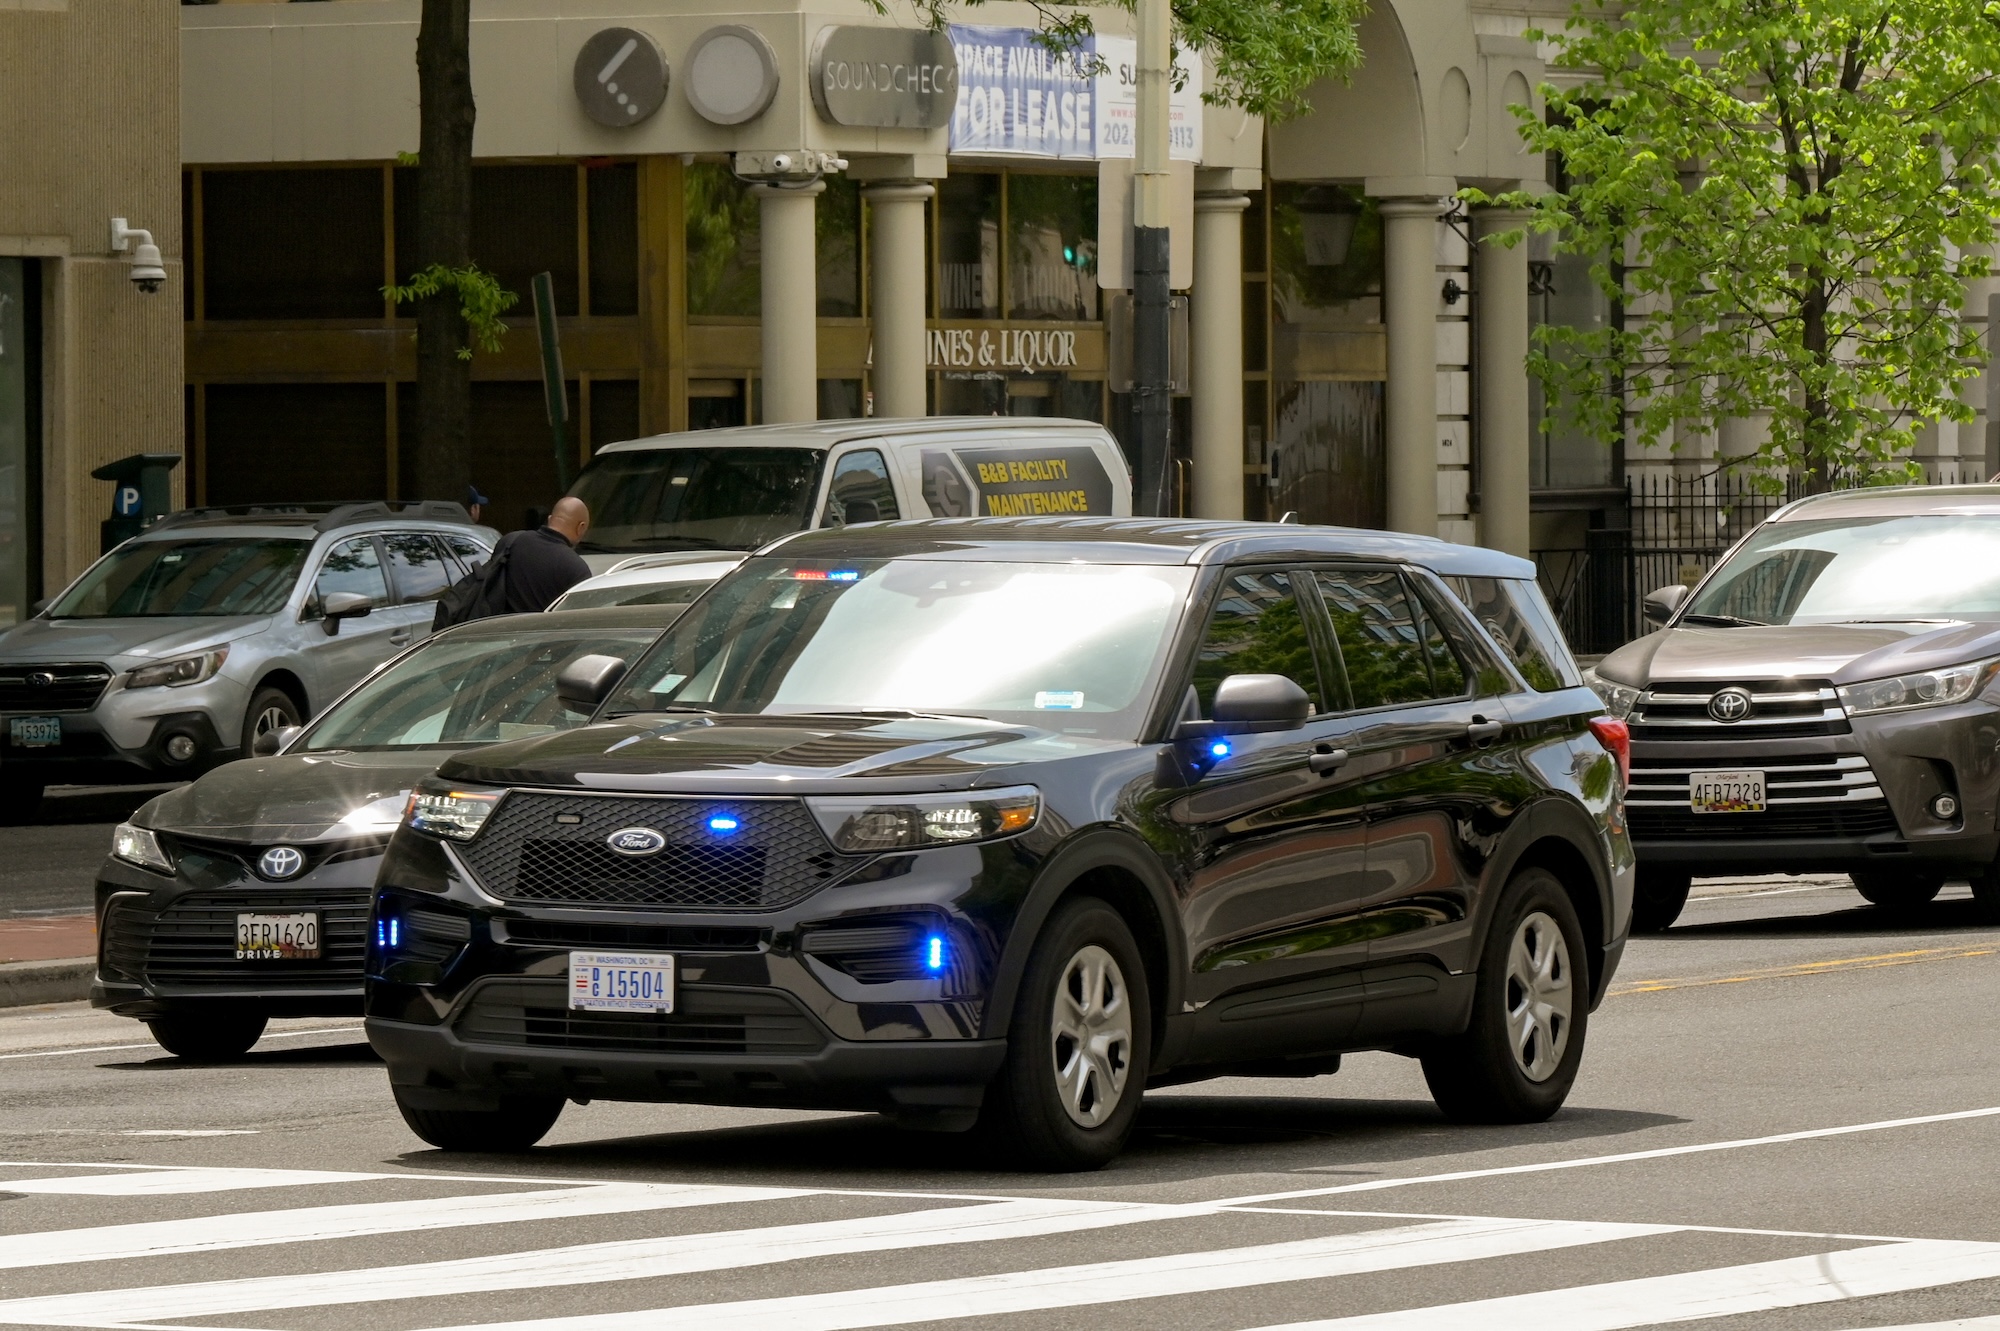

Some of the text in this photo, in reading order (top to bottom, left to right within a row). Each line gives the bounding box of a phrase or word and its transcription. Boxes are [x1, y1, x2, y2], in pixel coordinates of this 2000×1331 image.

[955, 43, 1003, 77] SPACE
[956, 86, 1091, 141] FOR LEASE
[926, 329, 1078, 375] INES & LIQUOR
[977, 459, 1068, 484] B&B FACILITY
[123, 487, 139, 515] P
[986, 489, 1088, 517] MAINTENANCE
[1694, 782, 1761, 805] 4FB7328
[619, 834, 651, 848] Ford
[240, 922, 316, 949] 3FR1620
[639, 957, 648, 965] DC
[607, 969, 663, 999] 15504
